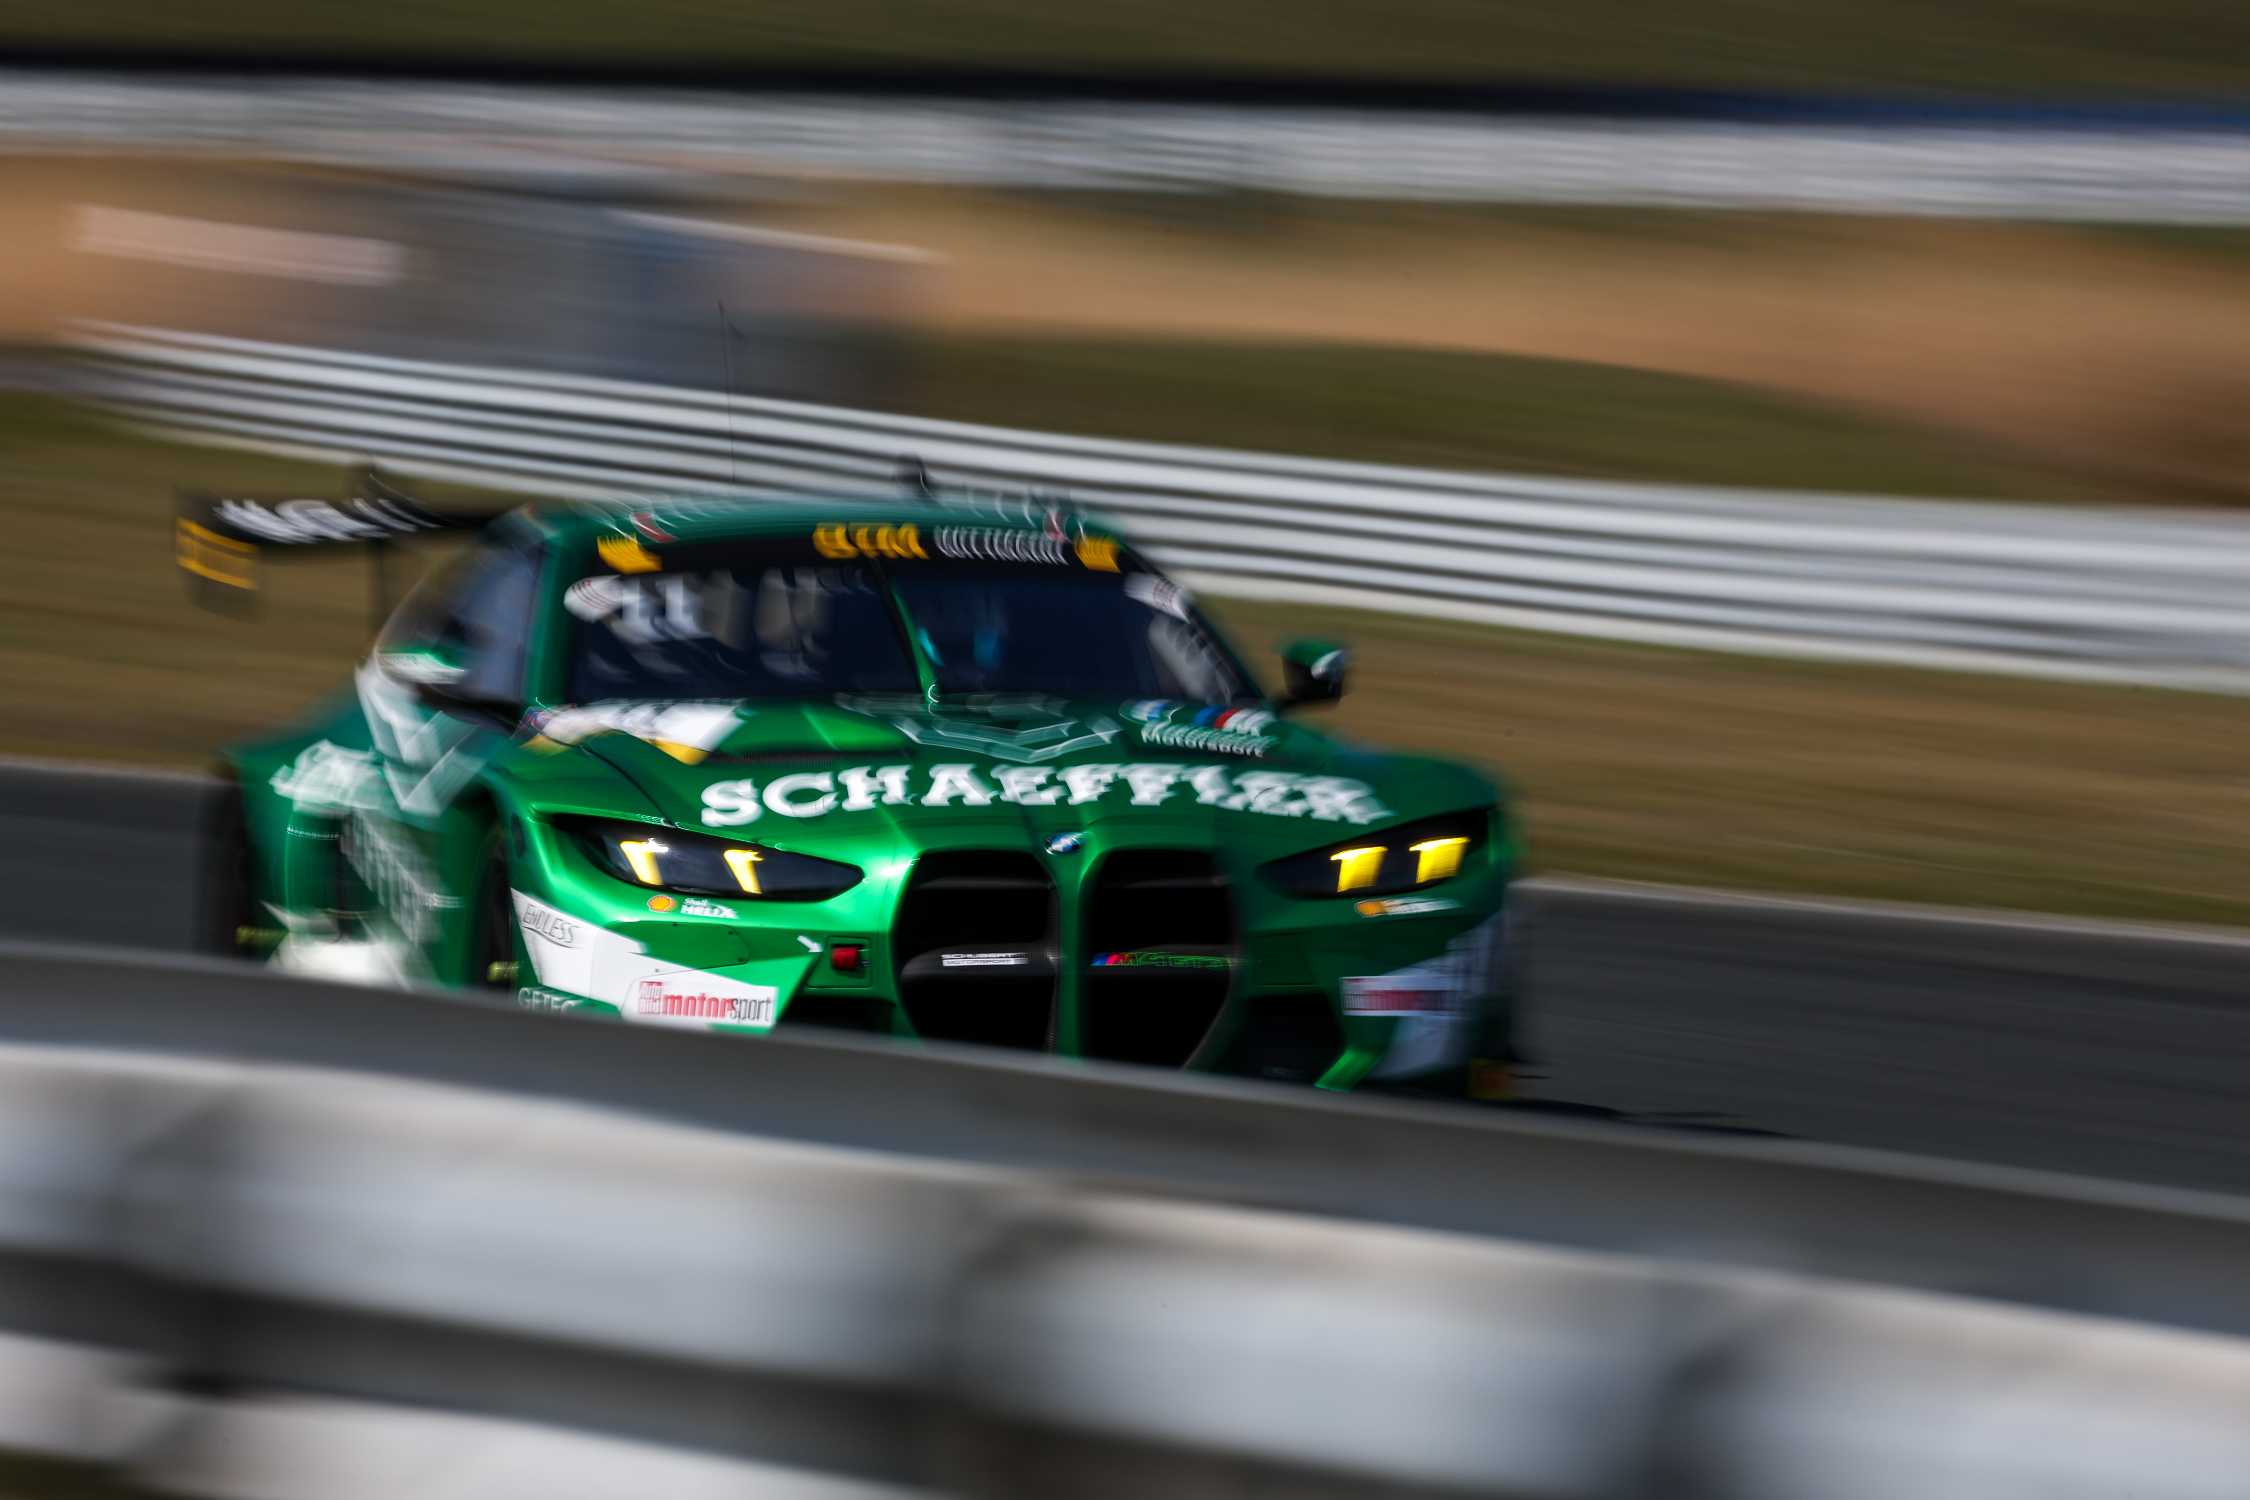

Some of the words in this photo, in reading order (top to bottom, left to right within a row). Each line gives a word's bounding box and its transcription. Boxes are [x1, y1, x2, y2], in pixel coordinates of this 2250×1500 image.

[701, 763, 1390, 826] SCHAEFFLER
[523, 904, 577, 943] ENDLESS
[663, 993, 771, 1023] motorsport
